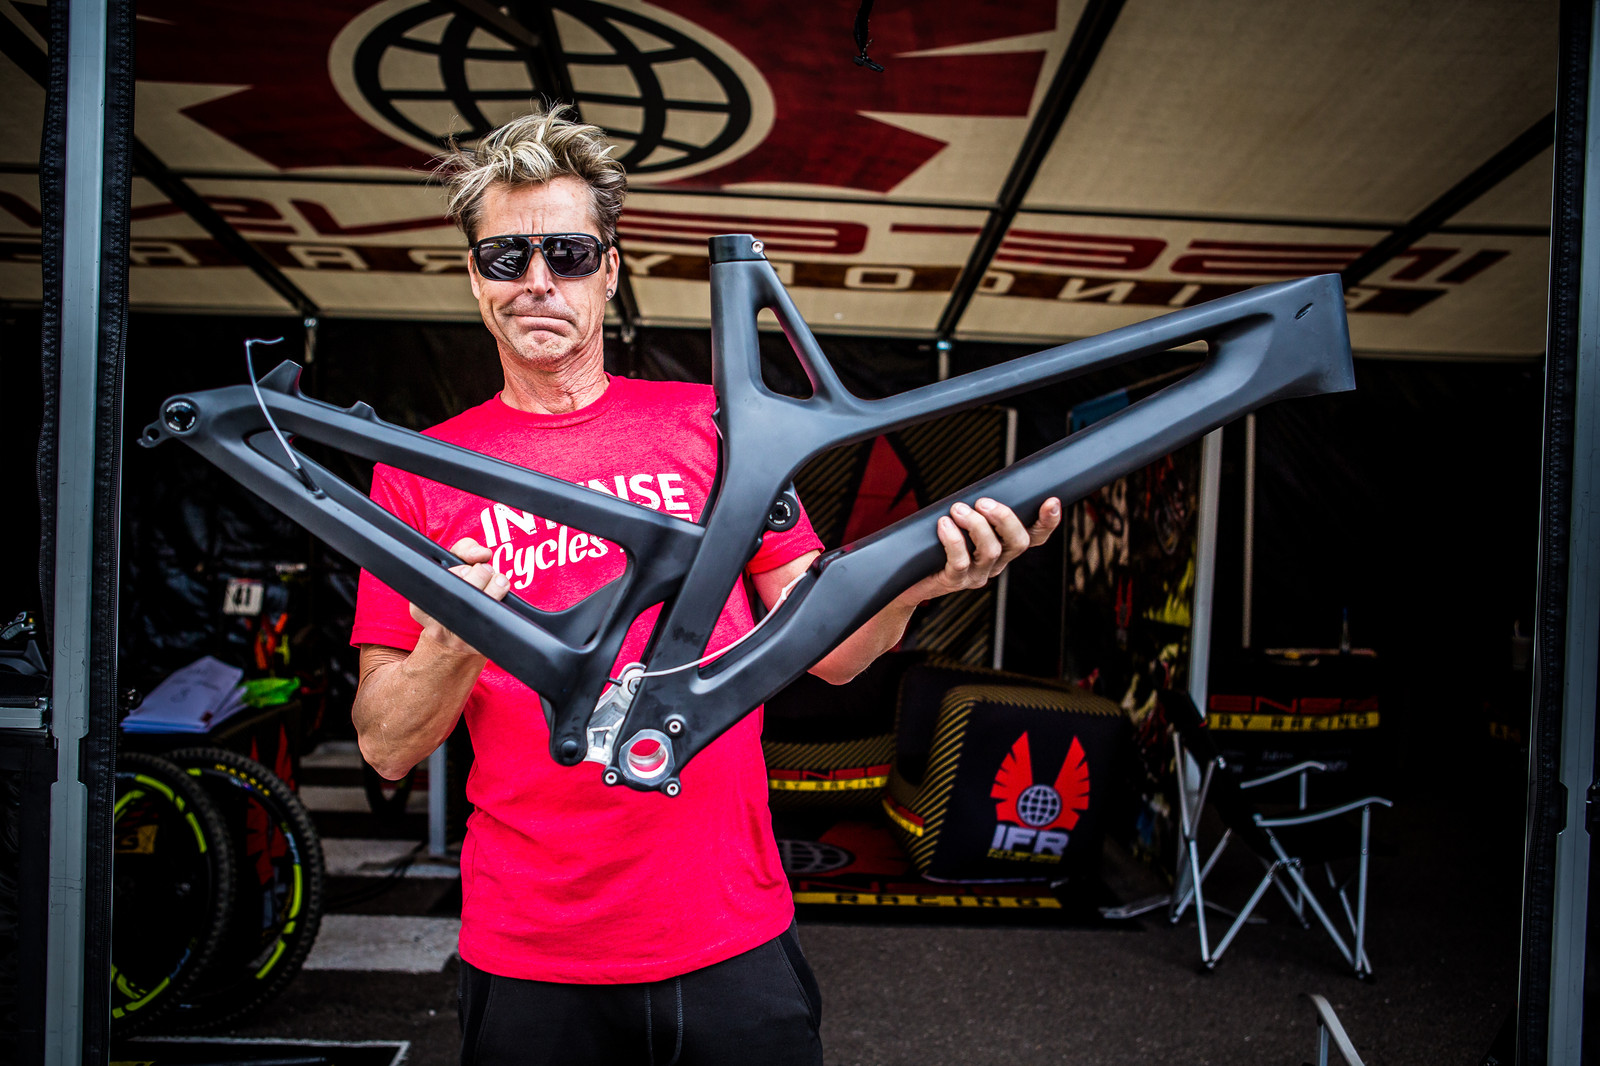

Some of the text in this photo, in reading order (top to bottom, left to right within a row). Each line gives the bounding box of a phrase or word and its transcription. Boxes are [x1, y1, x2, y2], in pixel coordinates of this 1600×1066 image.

[480, 473, 691, 548] INNSE
[492, 525, 609, 590] Cycles
[990, 822, 1070, 857] IFR
[835, 893, 1041, 909] RACING
